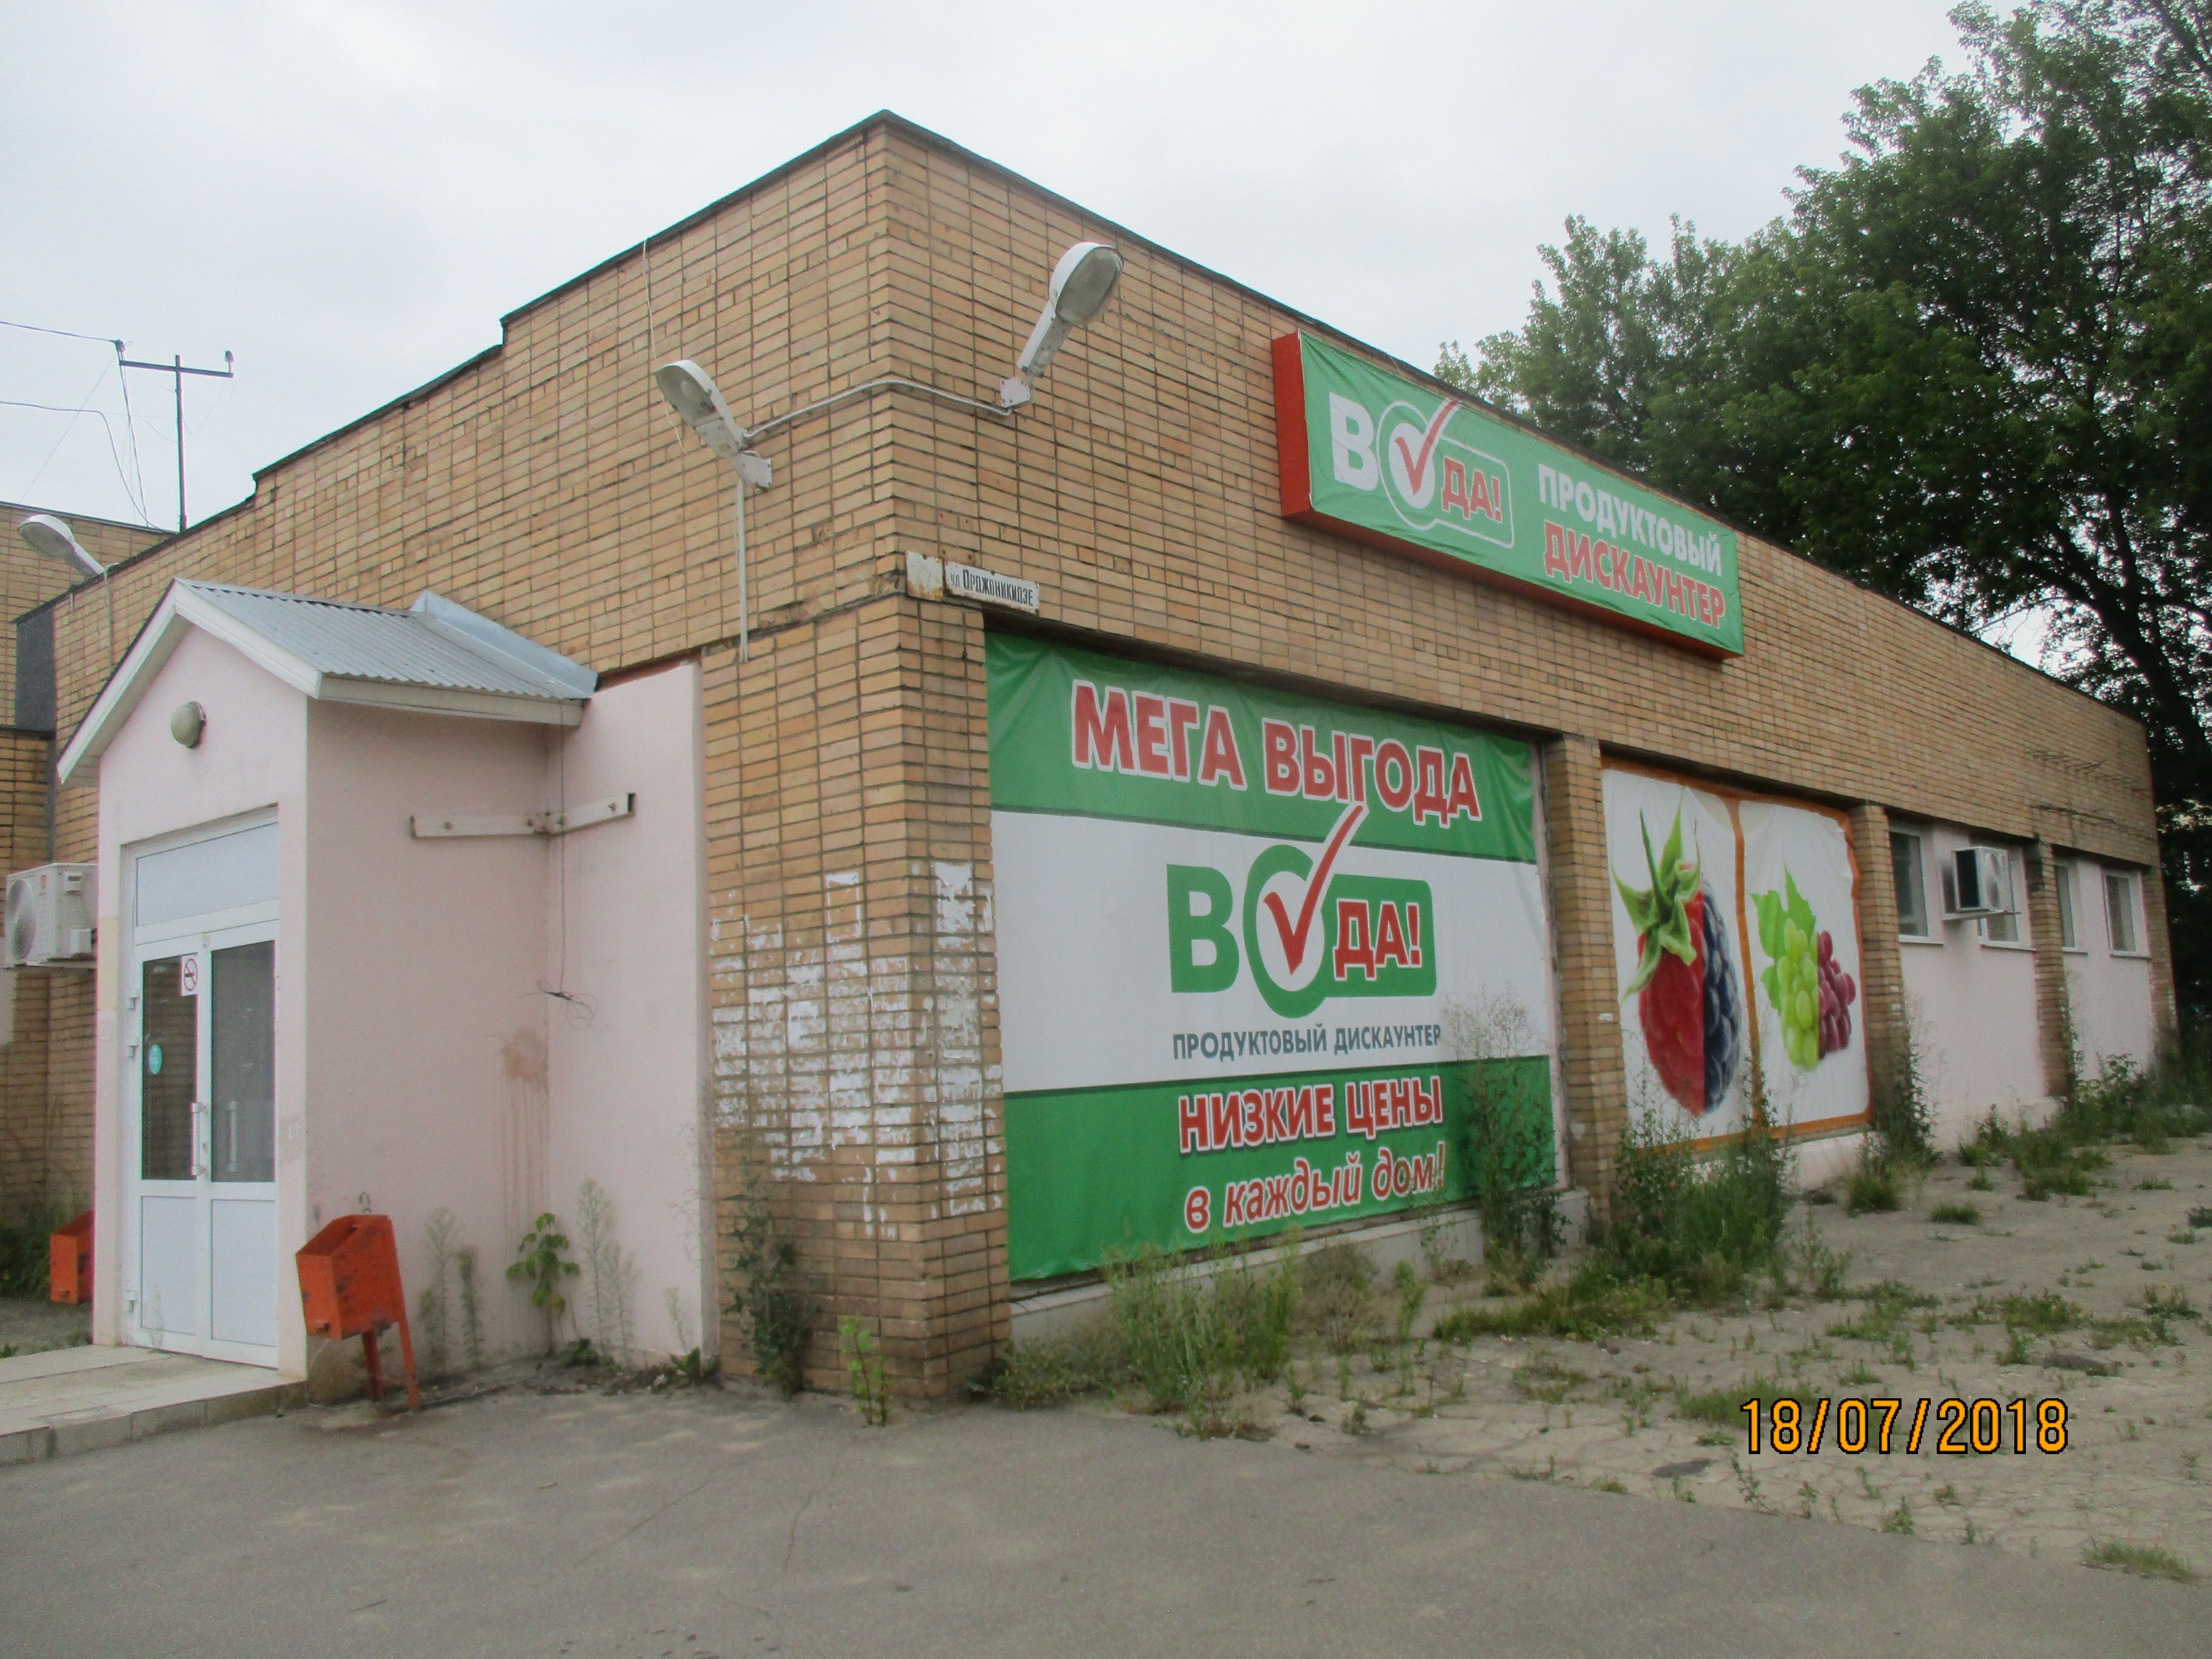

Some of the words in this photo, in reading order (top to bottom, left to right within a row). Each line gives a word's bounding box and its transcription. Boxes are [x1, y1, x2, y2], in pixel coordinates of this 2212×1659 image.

[1538, 463, 1723, 577] ПРОДУКТОВЫЙ
[1543, 520, 1726, 629] ДИСКАУНТЕР
[1071, 680, 1247, 791] МЕГА
[1261, 717, 1483, 829] ВЫГОДА
[1173, 1023, 1327, 1062] ПРОДУКТОВЫЙ
[1333, 1024, 1441, 1055] ДИСКАУНТЕР
[1178, 1084, 1336, 1153] НИЗКИЕ
[1345, 1075, 1443, 1140] ЦЕНЫ
[1184, 1185, 1211, 1234] в
[1222, 1150, 1363, 1228] каждый
[1372, 1141, 1446, 1201] дом!
